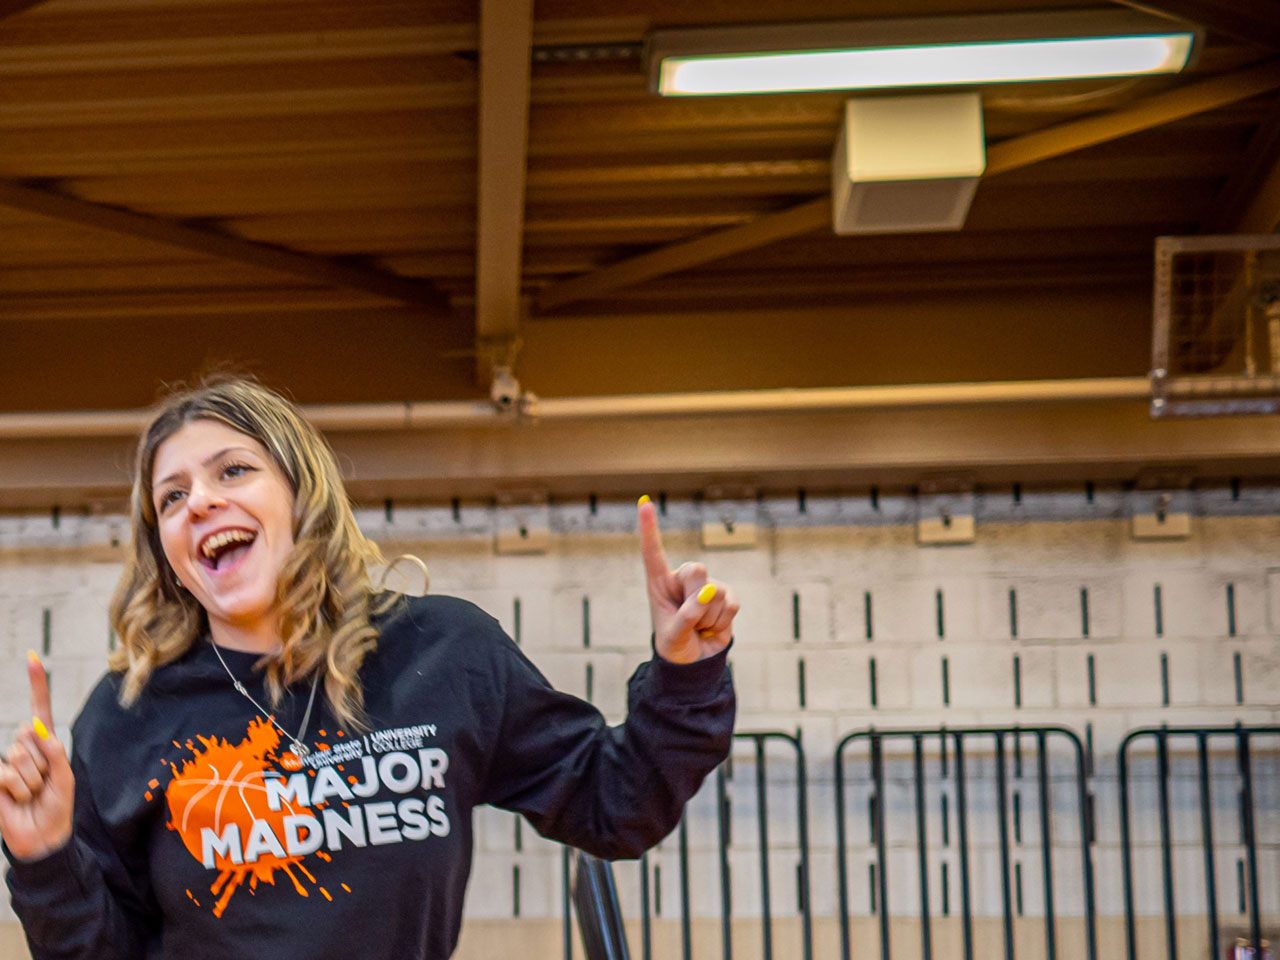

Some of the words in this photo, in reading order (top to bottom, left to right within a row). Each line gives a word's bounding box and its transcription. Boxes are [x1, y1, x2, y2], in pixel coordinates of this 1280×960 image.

[370, 724, 437, 742] UNIVERSITY
[372, 738, 424, 754] COLLEGE
[264, 748, 449, 811] MAJOR
[201, 796, 451, 870] MADNESS
